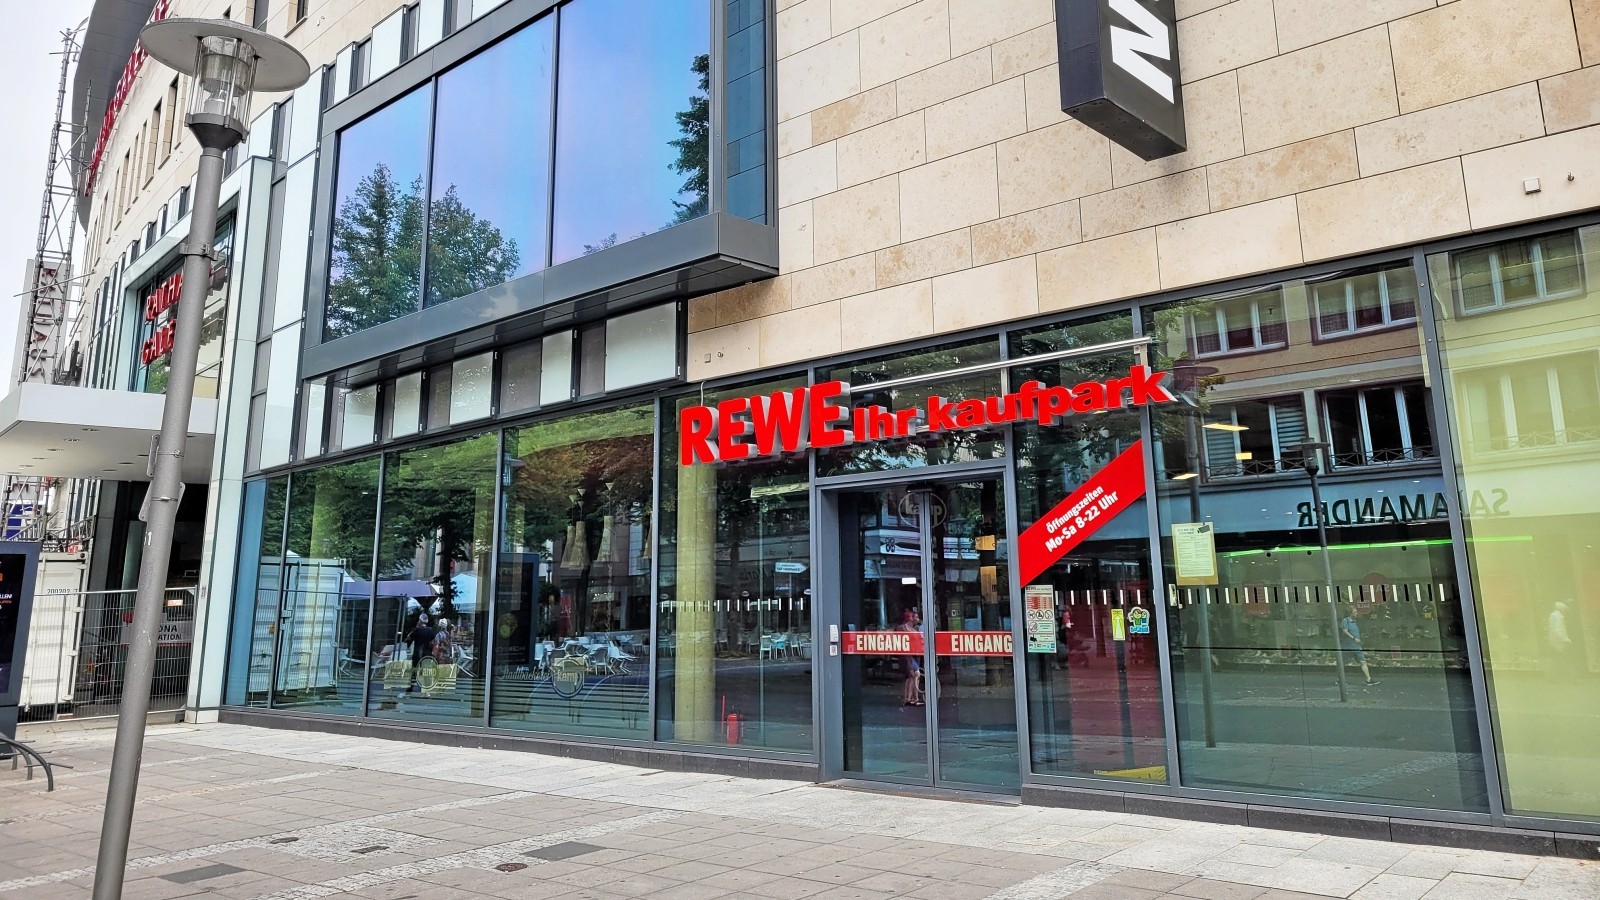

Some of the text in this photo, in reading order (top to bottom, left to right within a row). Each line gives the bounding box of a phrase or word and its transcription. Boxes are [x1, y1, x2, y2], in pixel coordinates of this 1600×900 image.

[679, 364, 1173, 466] REWE Ihr kaufpark
[1044, 490, 1120, 553] Mo-Sa 8-22 Uhr
[1046, 485, 1104, 534] Öffnungszeiten
[856, 633, 911, 652] EINGANG
[950, 633, 1013, 653] EINGANG
